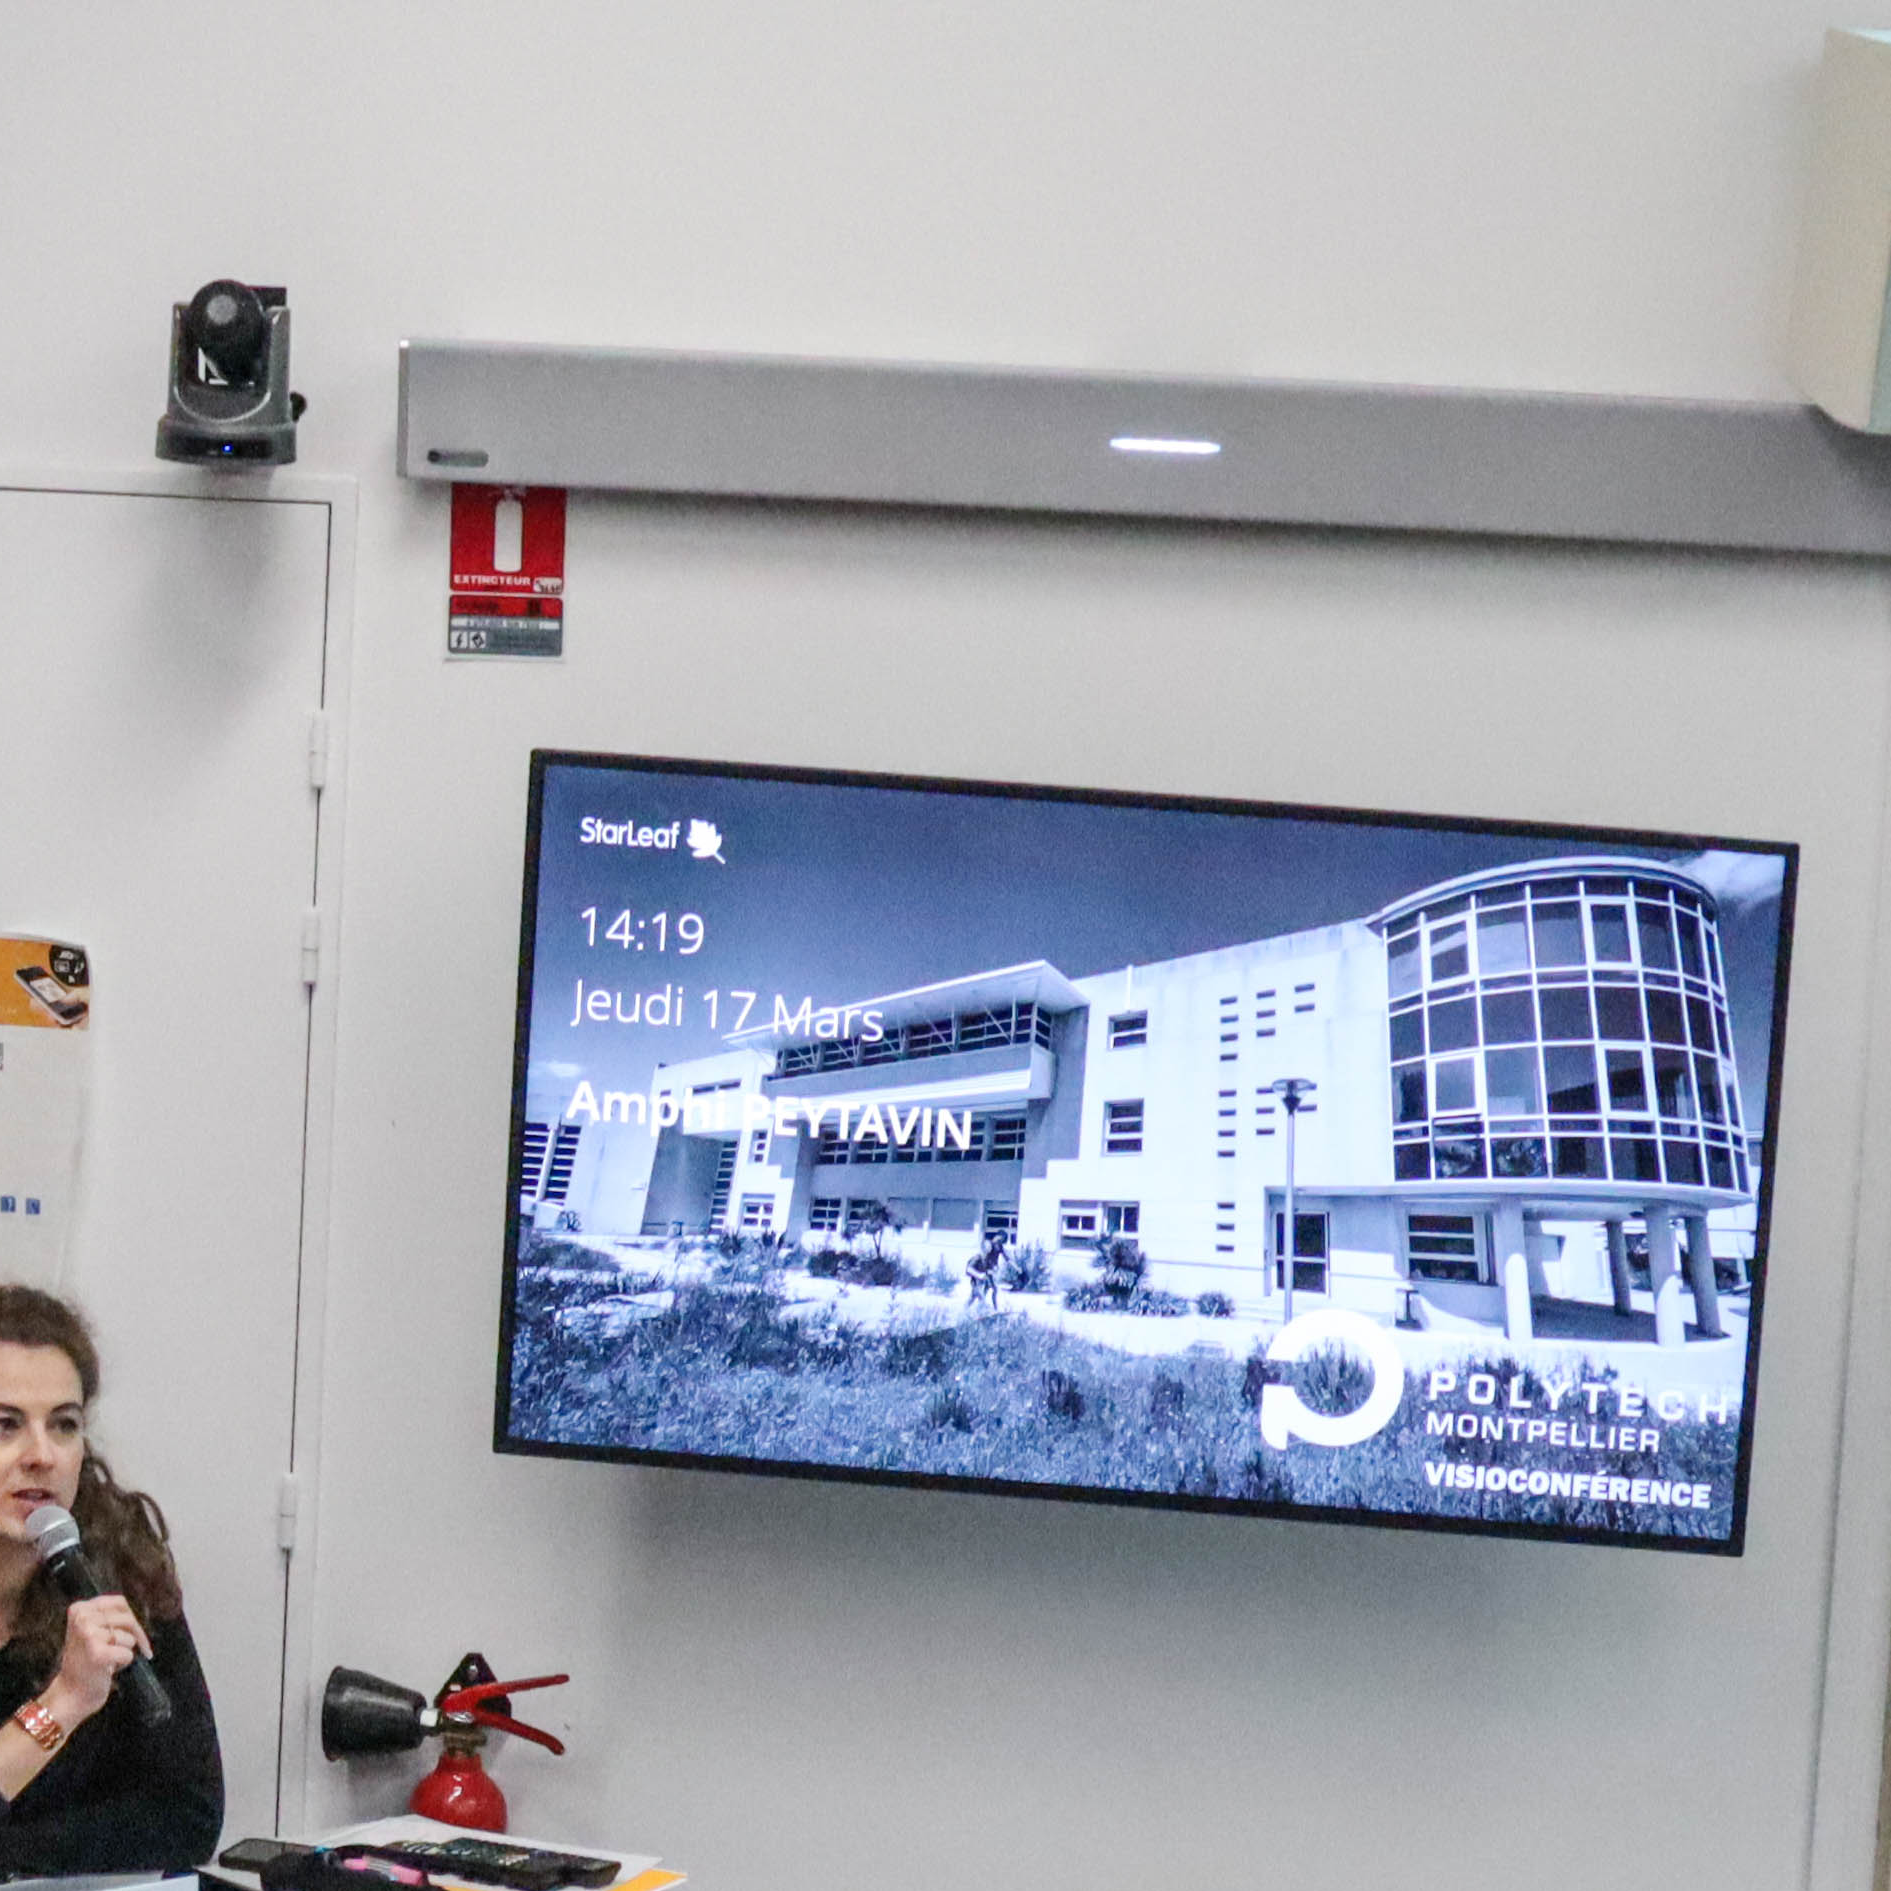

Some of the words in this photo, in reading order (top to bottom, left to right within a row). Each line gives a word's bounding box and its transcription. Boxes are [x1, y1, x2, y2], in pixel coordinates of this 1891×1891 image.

[453, 574, 531, 587] EXTINCTEUR
[579, 816, 680, 850] StarLeaf
[579, 906, 705, 955] 14:19
[570, 978, 684, 1028] Jeudi
[703, 988, 756, 1032] 17
[772, 995, 885, 1042] Mars
[743, 1093, 973, 1150] PEYTAVIN
[1427, 1370, 1729, 1426] POLYTECH
[1425, 1411, 1661, 1454] MONTPELLIER
[1424, 1462, 1712, 1510] VISIOCONFÉRENCE
